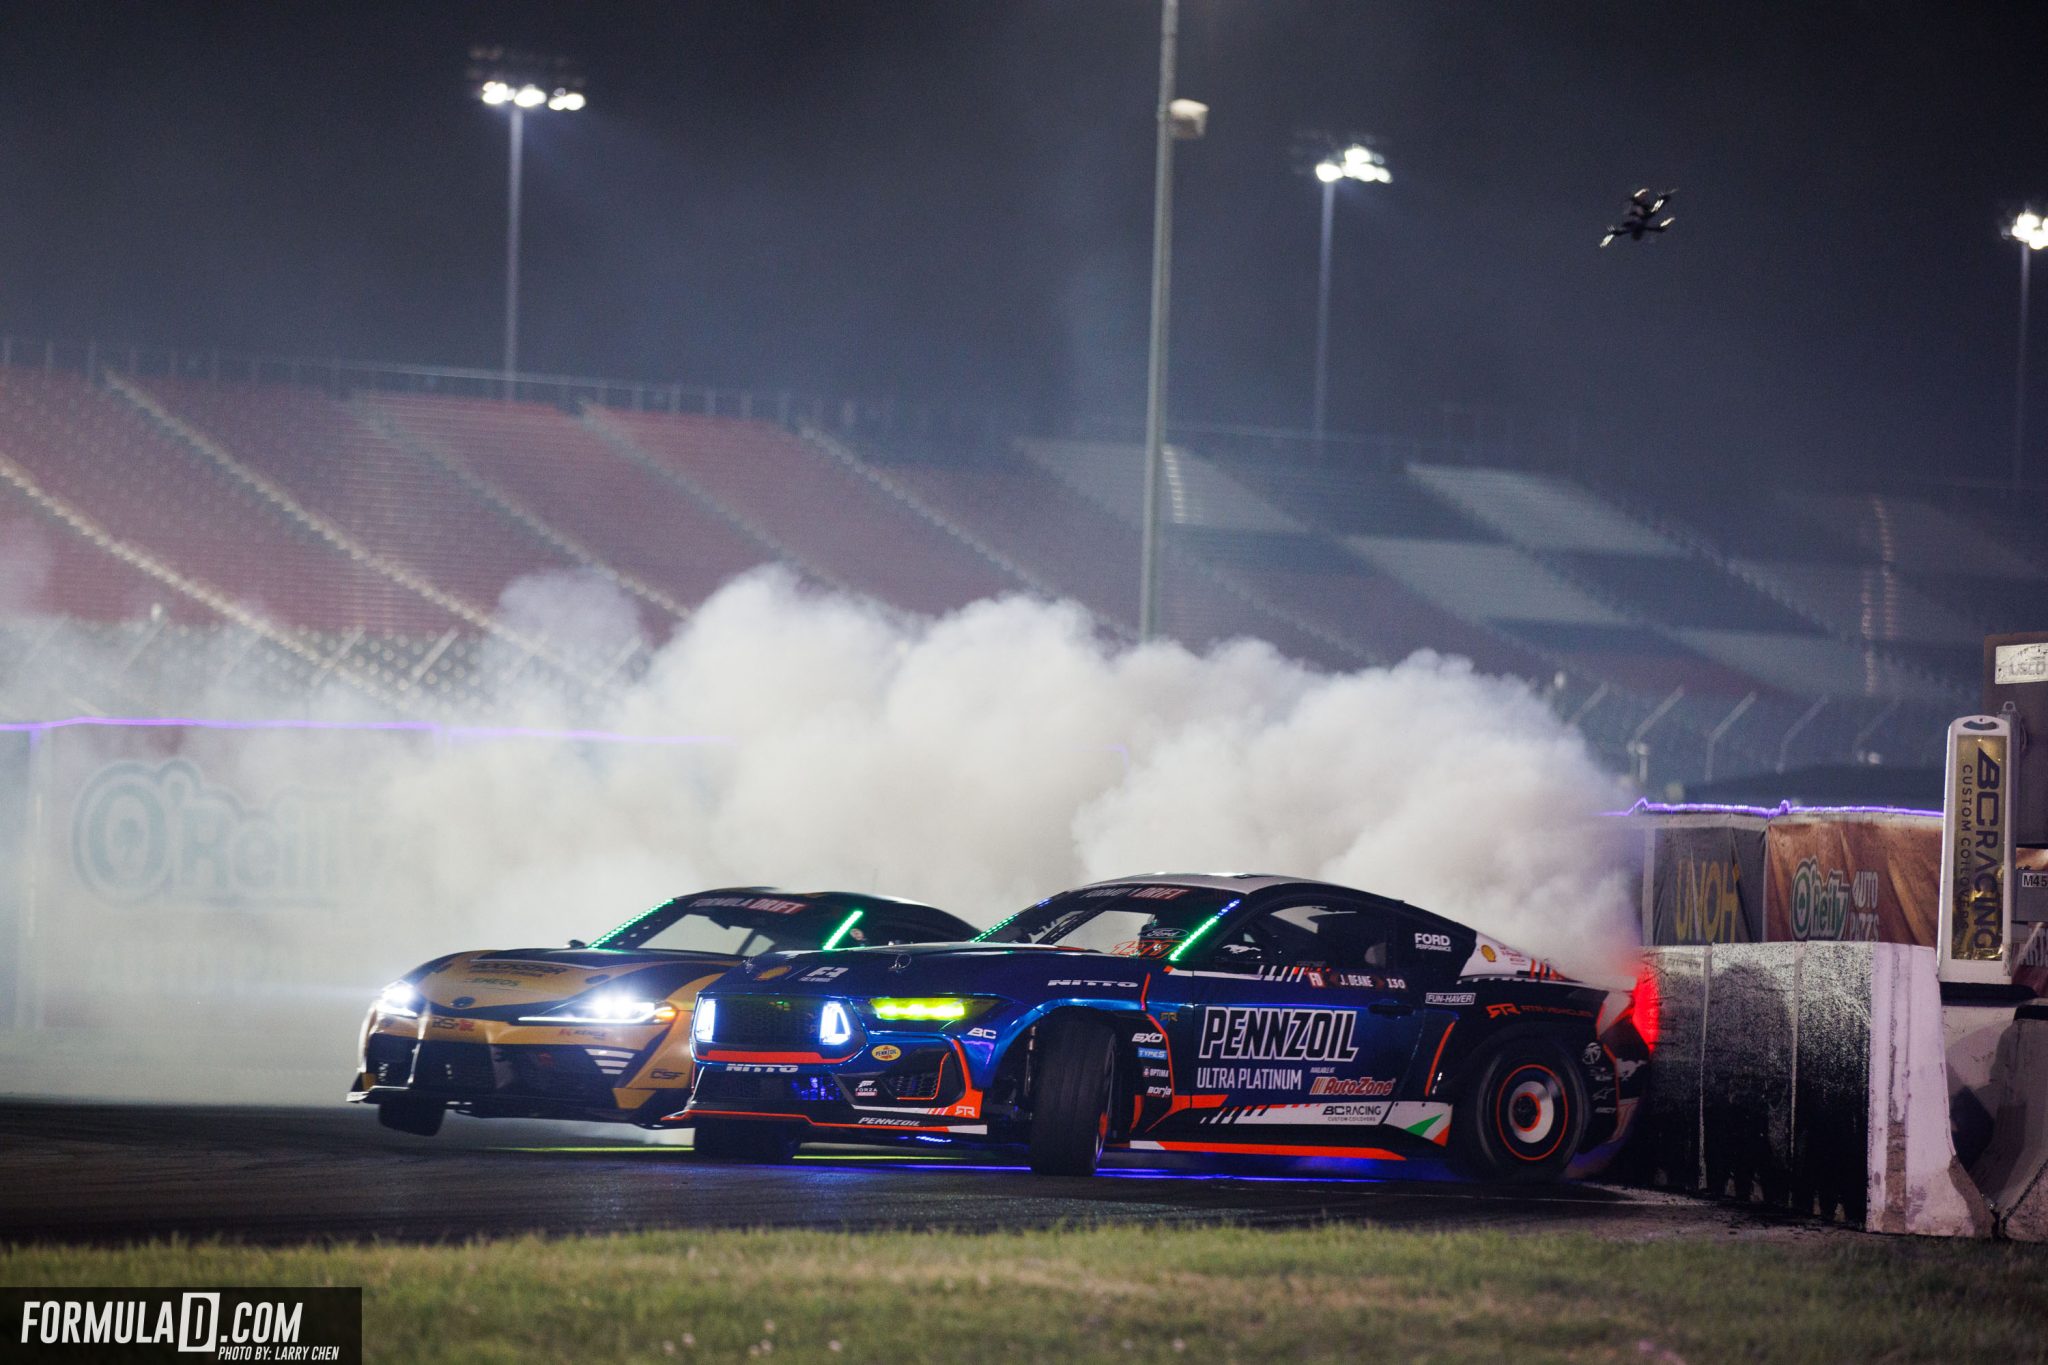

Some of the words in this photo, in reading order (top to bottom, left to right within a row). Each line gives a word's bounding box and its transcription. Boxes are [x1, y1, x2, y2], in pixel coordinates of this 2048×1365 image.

[1960, 764, 1973, 831] CUSTOM
[1131, 887, 1190, 900] DRIFT
[748, 898, 806, 914] DRIFT
[1676, 859, 1740, 942] UNOH
[1415, 933, 1450, 946] FORD
[1048, 979, 1138, 988] NITTO
[1340, 974, 1349, 986] J.
[1348, 975, 1374, 987] DEANE
[1386, 978, 1406, 989] 130
[967, 1027, 997, 1039] BC
[1199, 1006, 1359, 1062] PENNZOIL
[726, 1064, 798, 1073] NITTO
[1149, 1068, 1169, 1078] OPTIMA
[1197, 1067, 1236, 1089] ULTRA
[1238, 1069, 1302, 1090] PLATINUM
[1324, 1077, 1393, 1096] AutoZone
[858, 1117, 920, 1126] PENNZOIL
